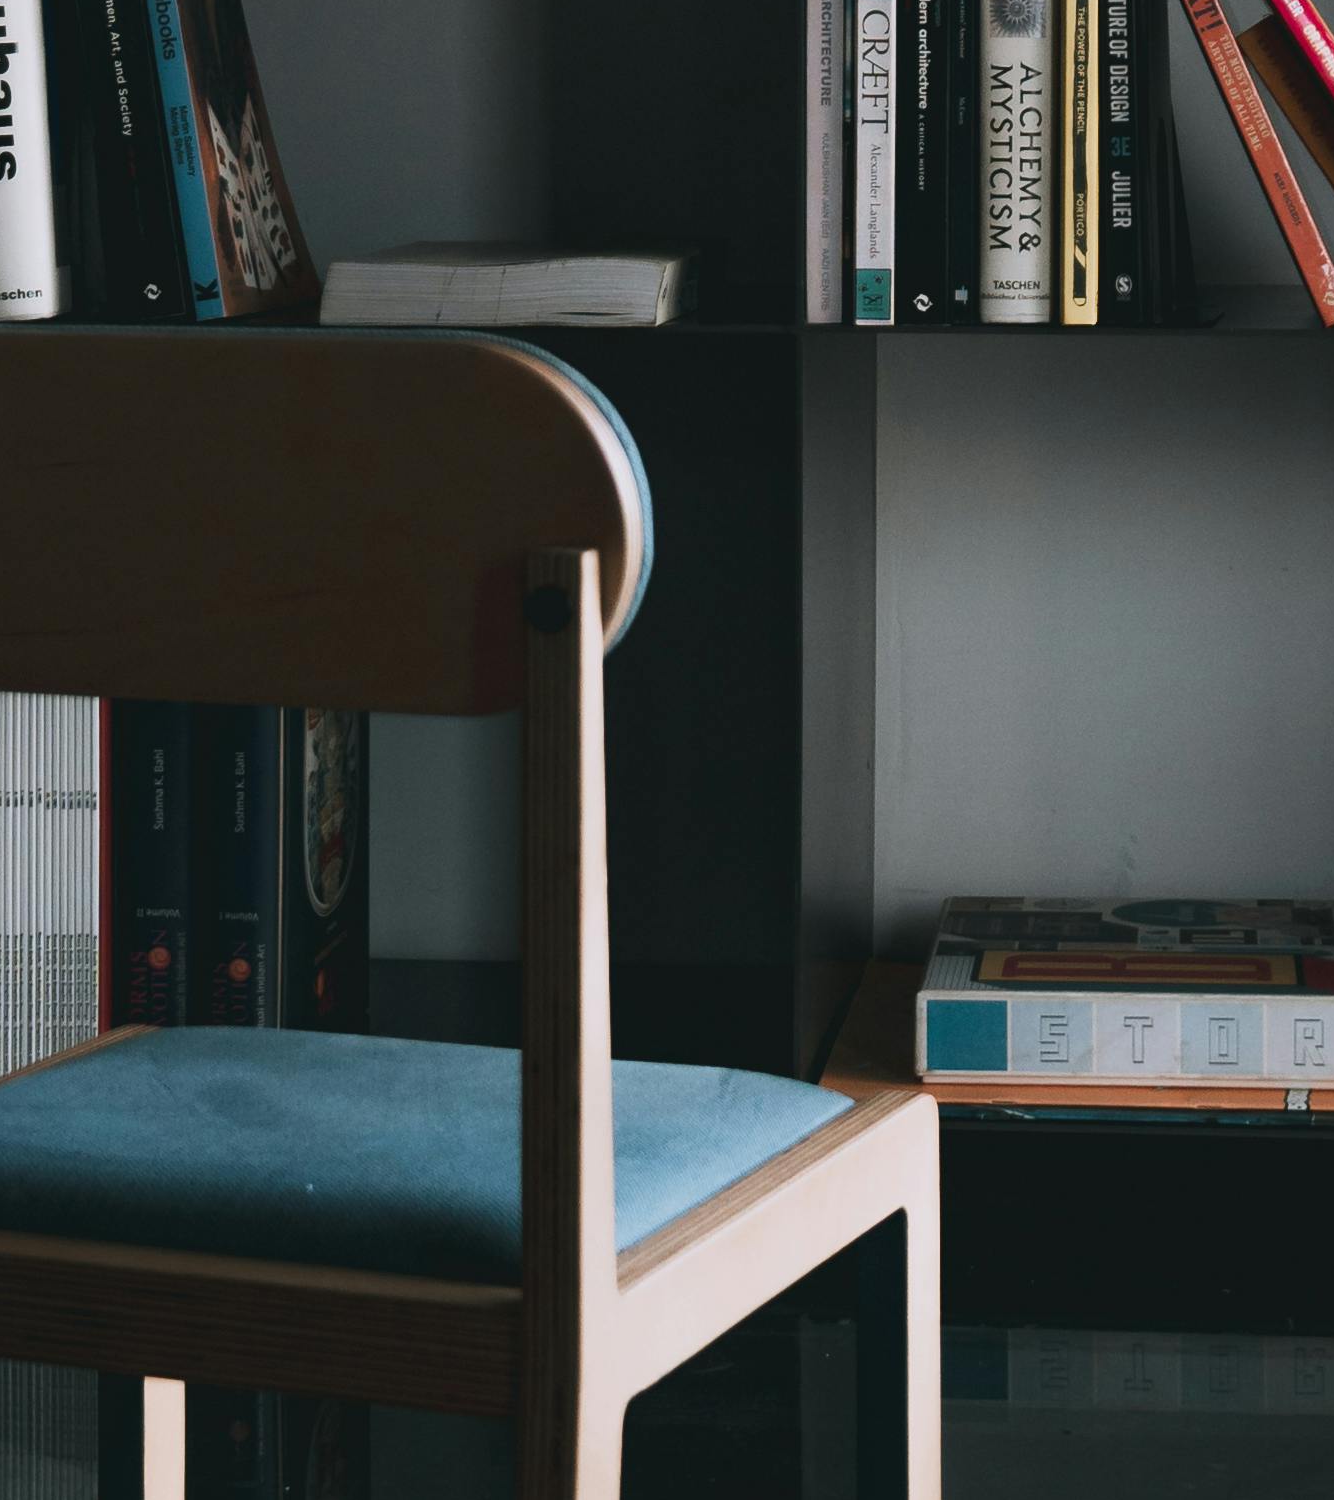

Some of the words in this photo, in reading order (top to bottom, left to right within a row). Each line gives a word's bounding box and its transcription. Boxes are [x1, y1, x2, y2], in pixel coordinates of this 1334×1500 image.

[108, 32, 124, 56] Art,
[1109, 39, 1128, 59] OF
[115, 60, 128, 84] and
[861, 10, 890, 134] CRÆFT
[1110, 64, 1129, 122] DESIGN
[115, 88, 134, 137] Society
[990, 64, 1013, 251] MYSTICISM
[1019, 62, 1041, 226] ALCHEMY
[1112, 171, 1131, 228] JULIER
[1020, 232, 1041, 253] &
